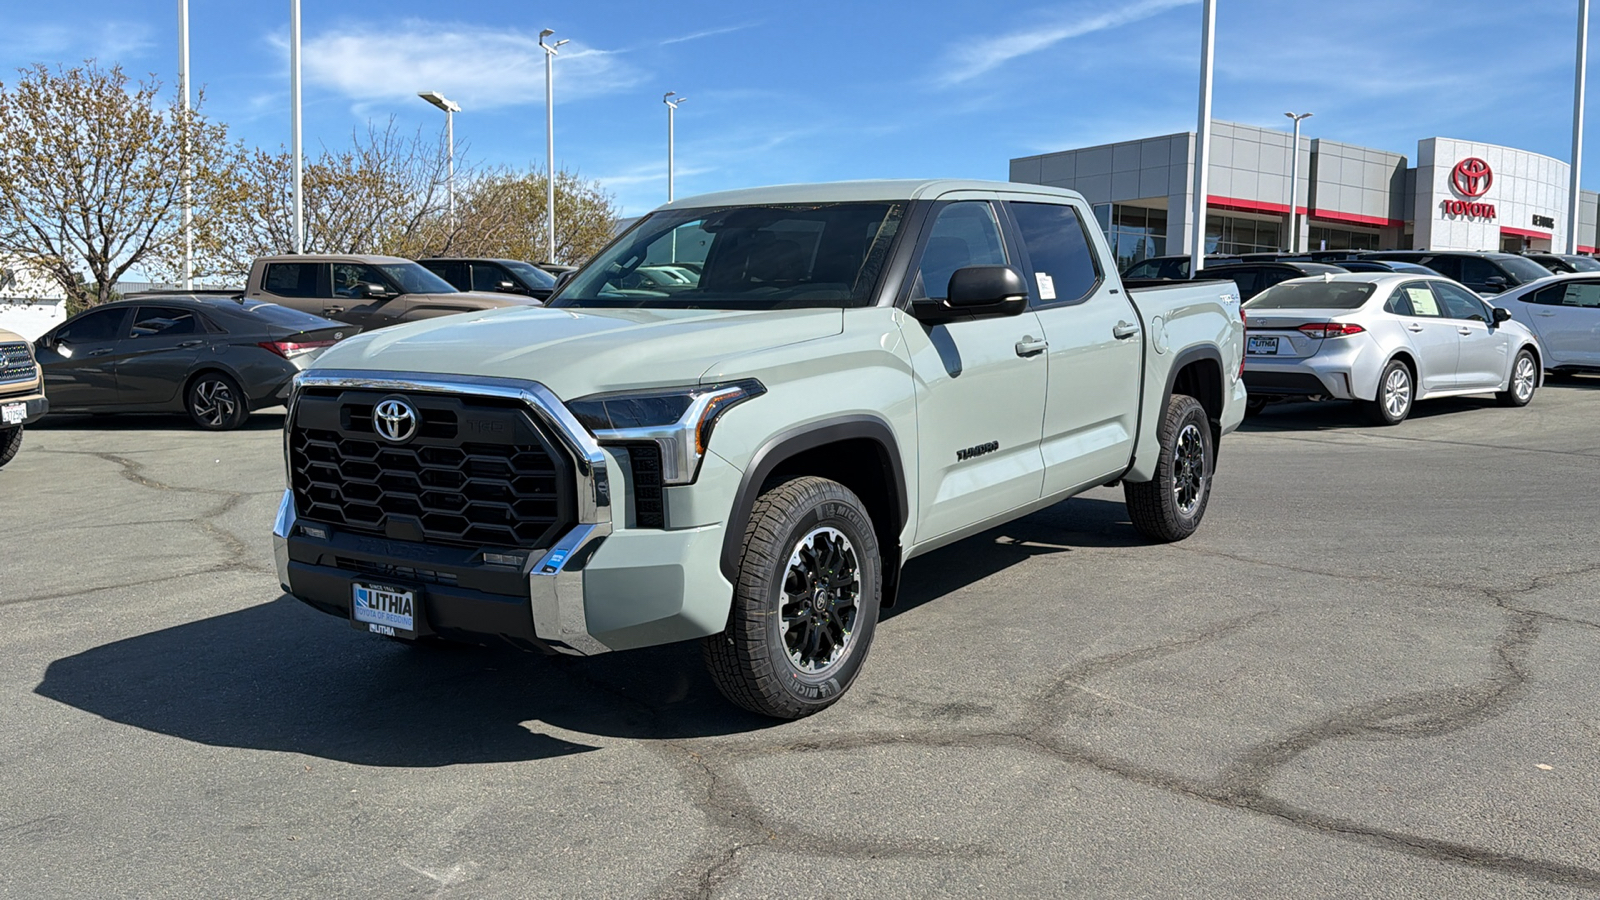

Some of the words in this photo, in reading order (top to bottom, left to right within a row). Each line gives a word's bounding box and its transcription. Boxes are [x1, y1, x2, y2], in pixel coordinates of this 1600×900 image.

[1443, 200, 1497, 218] TOYOTA
[956, 440, 999, 462] TUNDRA
[836, 505, 876, 552] MICHELIN
[368, 591, 412, 617] LITHIA
[356, 607, 377, 619] TOYOTA
[377, 611, 385, 619] OF
[386, 613, 413, 626] REDDING
[376, 624, 395, 637] LITHIA
